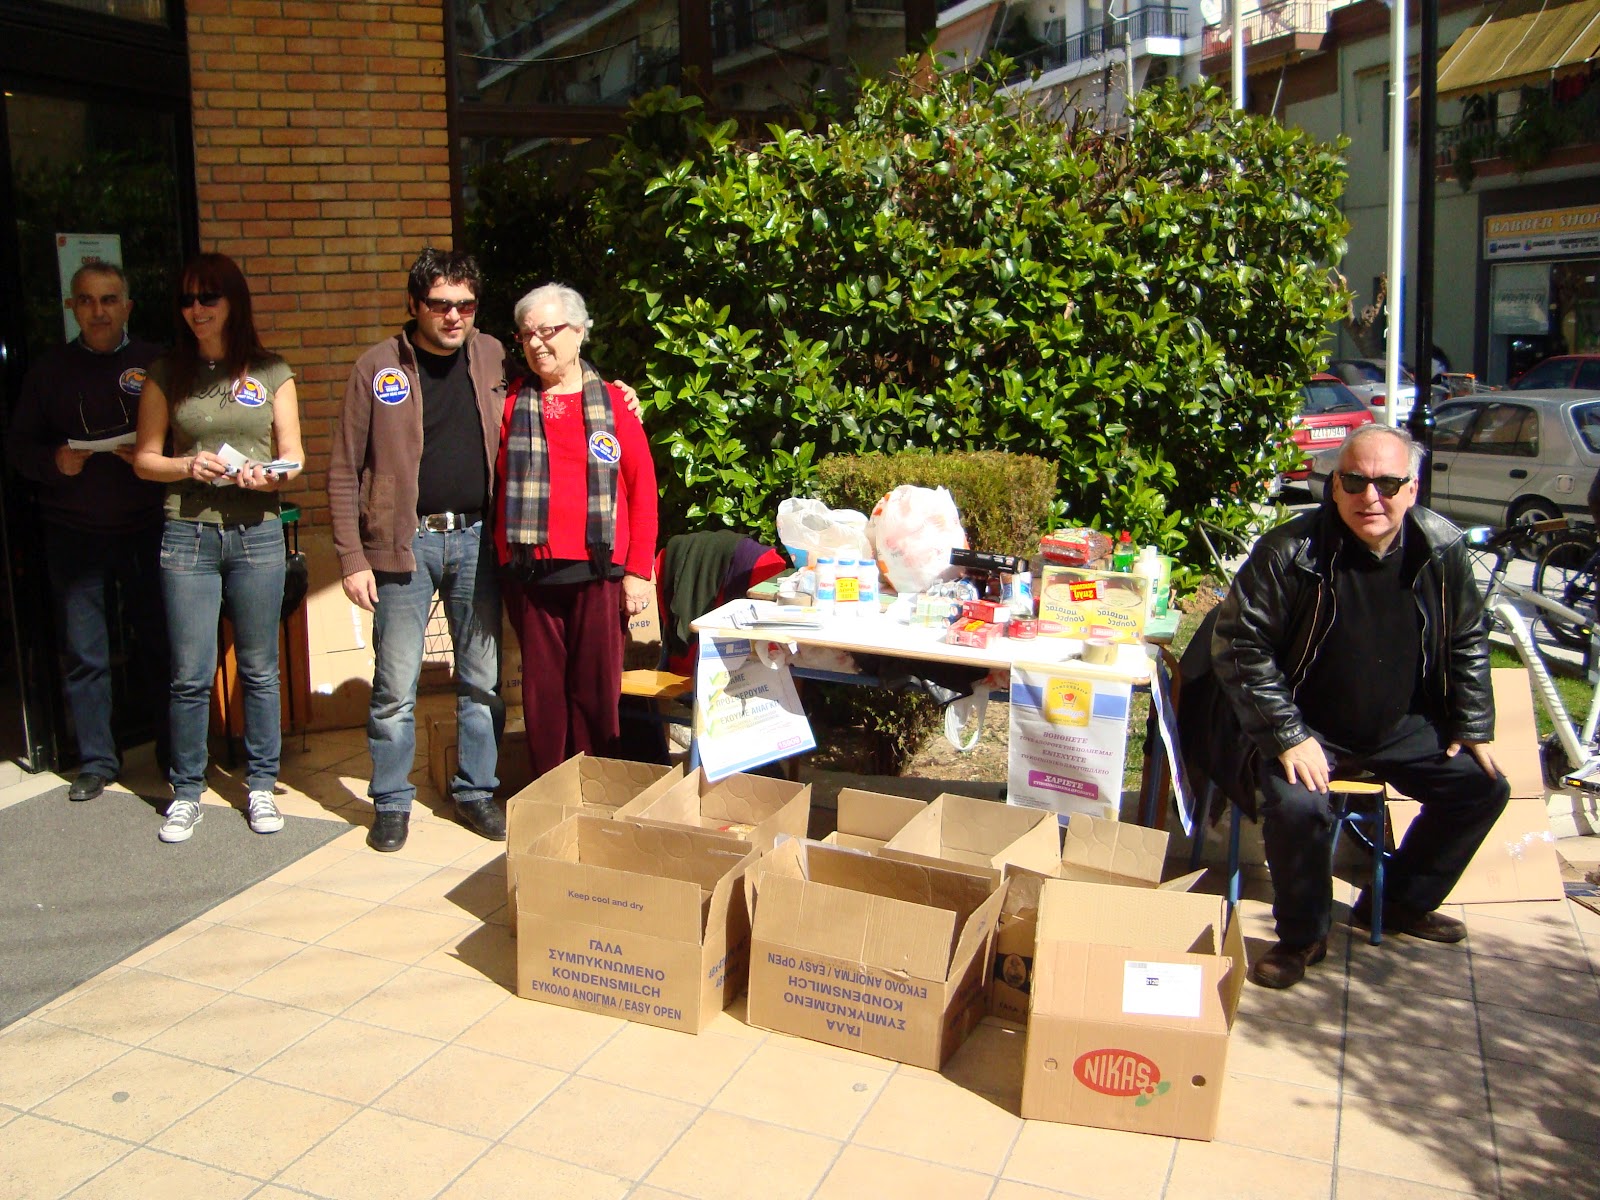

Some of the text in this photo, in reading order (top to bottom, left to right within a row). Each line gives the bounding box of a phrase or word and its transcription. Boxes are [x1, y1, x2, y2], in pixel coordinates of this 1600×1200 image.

[1490, 216, 1553, 233] BARBER
[1044, 775, 1084, 790] ΧΑΡΙΣΤΕ
[568, 890, 644, 912] Keep cool and dry
[589, 939, 623, 956] ΓΑΛΑ
[548, 948, 665, 981] ΣΥΜΠΥΚΝΩΜΕΝΟ
[767, 952, 796, 969] OPEN
[799, 959, 826, 976] EASY
[552, 966, 661, 998] KONDENSMILCH
[833, 968, 882, 989] ΑΝΟΙΓΜΑ
[532, 979, 570, 997] ΕΥΚΟΛΟ
[572, 988, 617, 1008] ΑΝΟΙΓΜΑ
[624, 1000, 651, 1014] EASY
[653, 1005, 682, 1020] OPEN
[788, 975, 903, 1012] KONDENSMILCH
[884, 981, 928, 999] ΕΥΚΟΛΟ
[783, 992, 907, 1031] ΣΥΜΠΥΚΝΩΜΕΝΟ
[826, 1018, 861, 1037] ΓΑΛΑ
[1084, 1054, 1151, 1090] NIKAS
